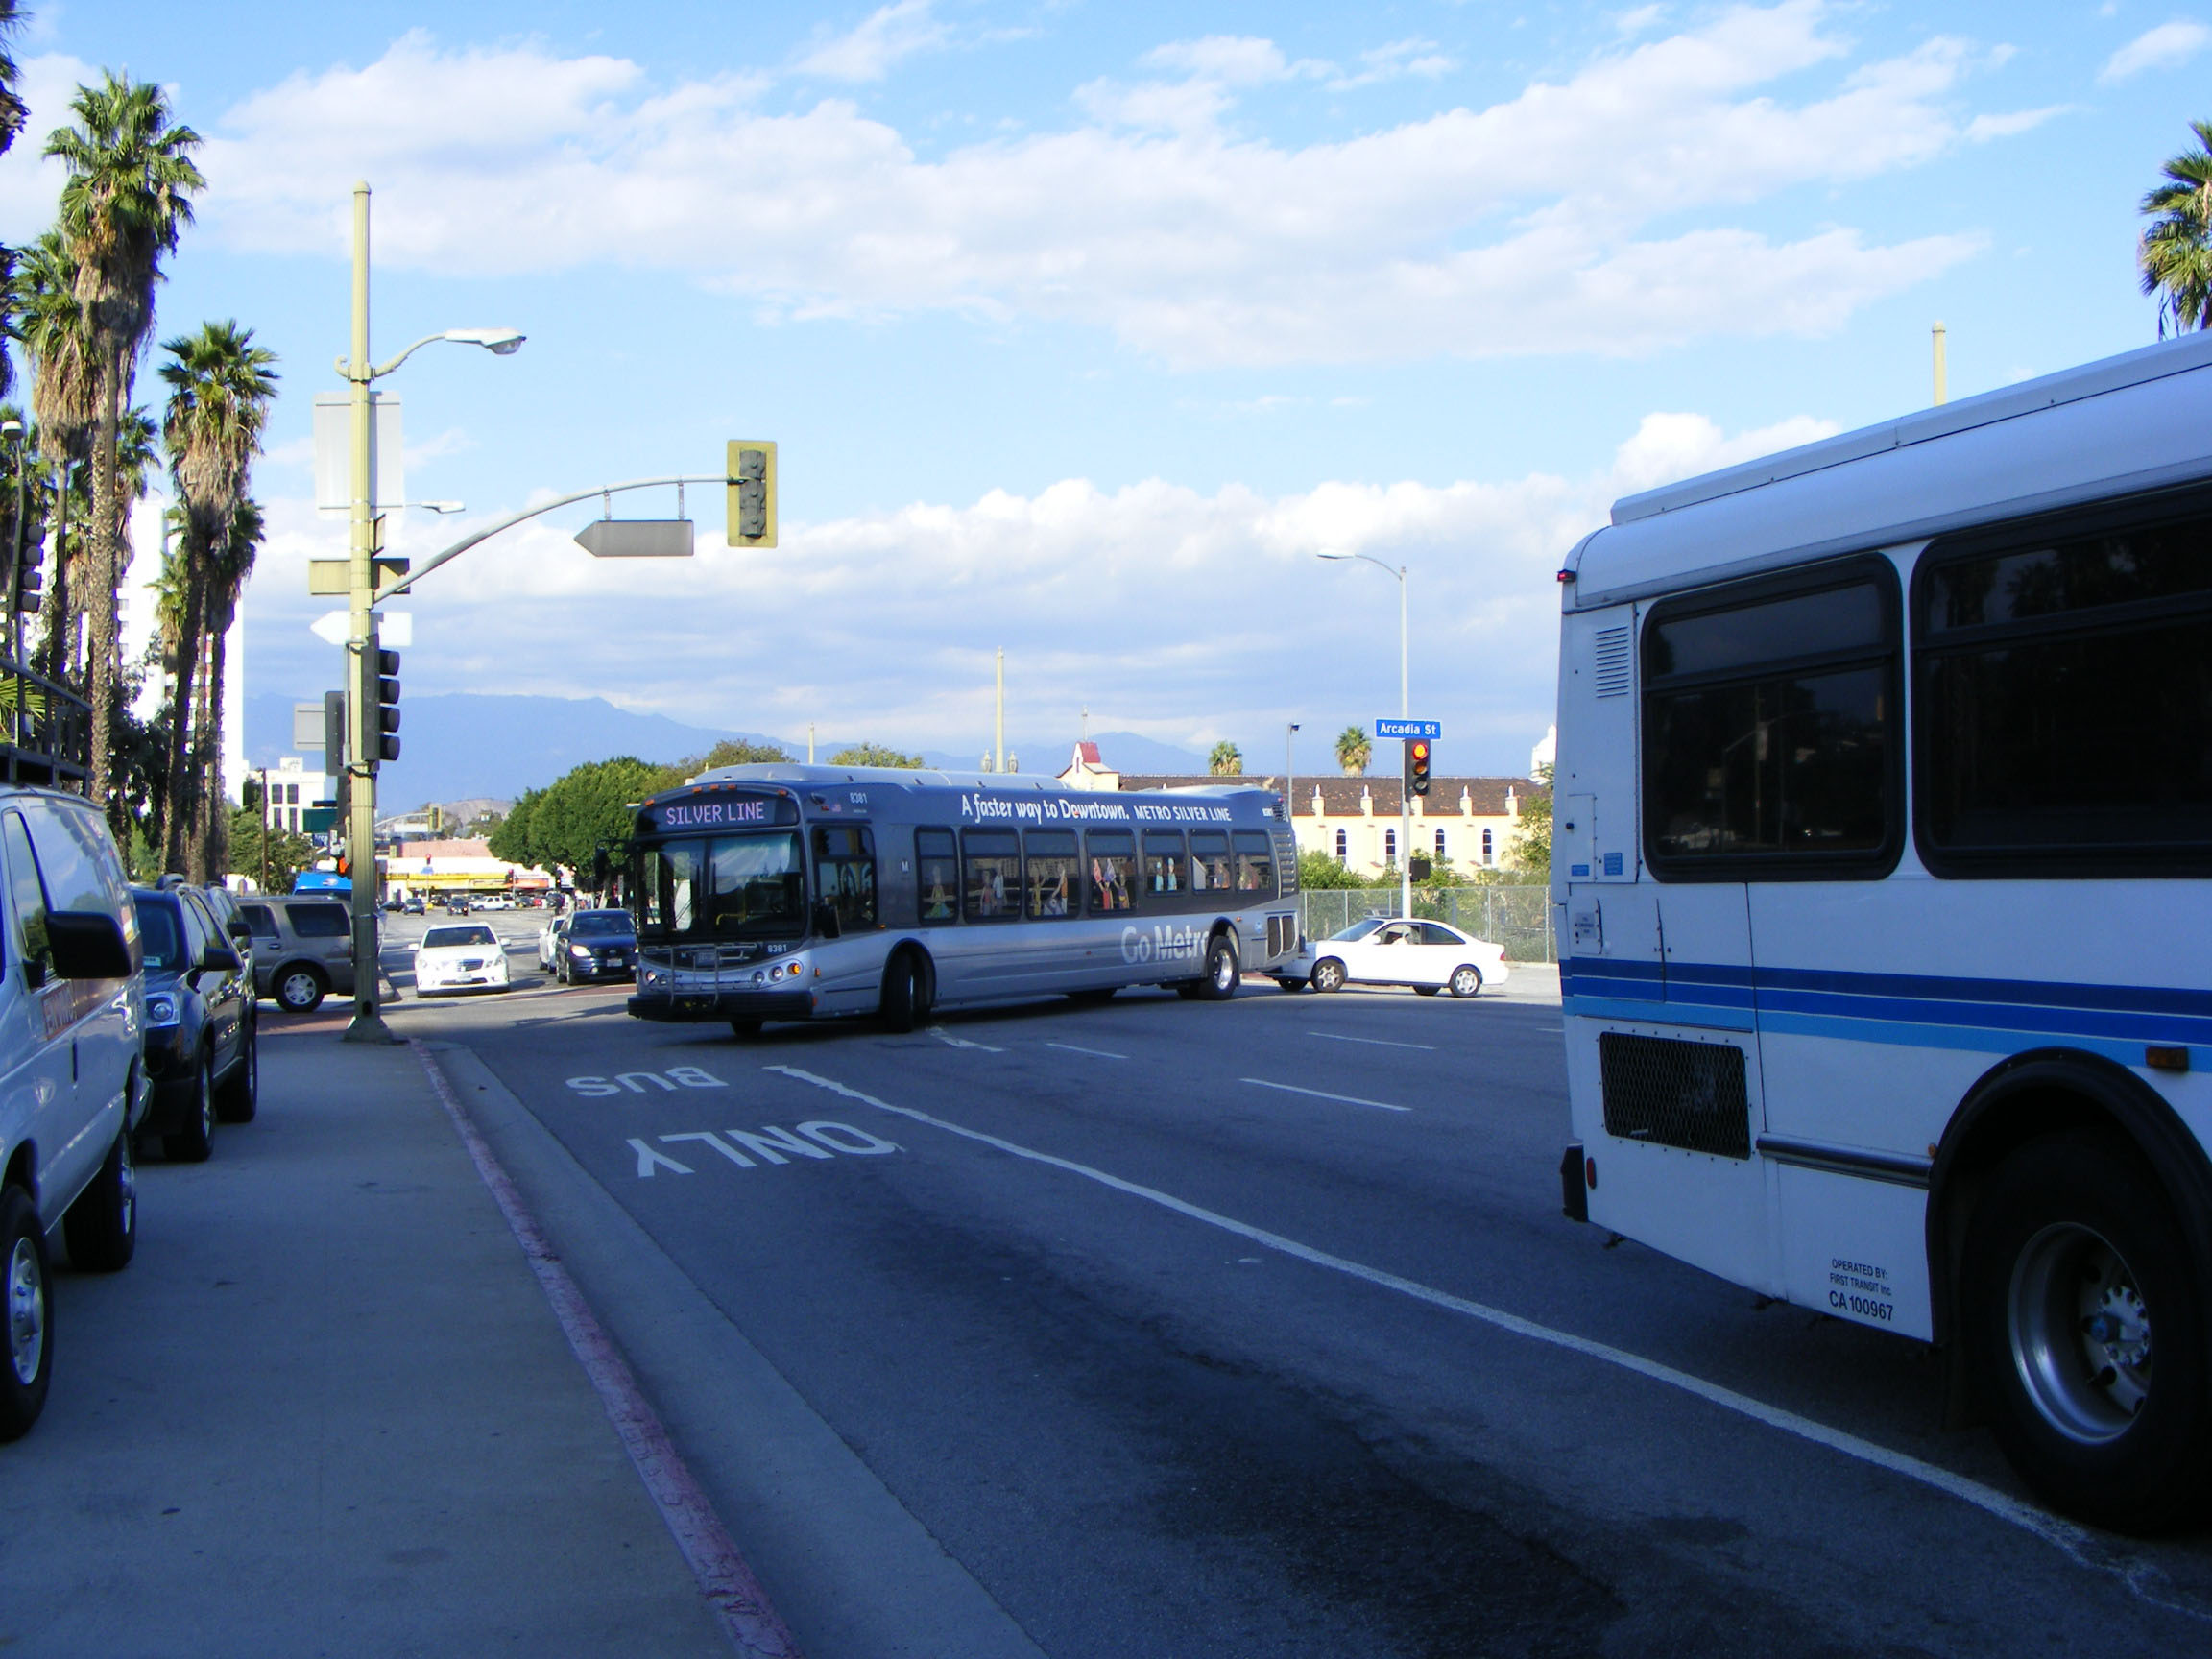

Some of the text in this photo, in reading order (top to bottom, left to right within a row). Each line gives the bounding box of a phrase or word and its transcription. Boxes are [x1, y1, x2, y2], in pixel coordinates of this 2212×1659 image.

[1380, 722, 1436, 735] Arcadia St
[665, 801, 765, 826] SILVER LINE
[961, 793, 1130, 826] A faster way to Downtown.
[1133, 805, 1233, 823] METRO SILVER LINE
[767, 943, 788, 954] 8381
[1120, 926, 1152, 964] Go
[565, 1066, 730, 1096] BUS
[625, 1120, 903, 1178] ONLY
[1832, 1258, 1887, 1280] OPERATED BY:
[1830, 1272, 1848, 1286] FIRST
[1850, 1277, 1880, 1293] TRANSIT
[1829, 1290, 1893, 1321] CA 100967
